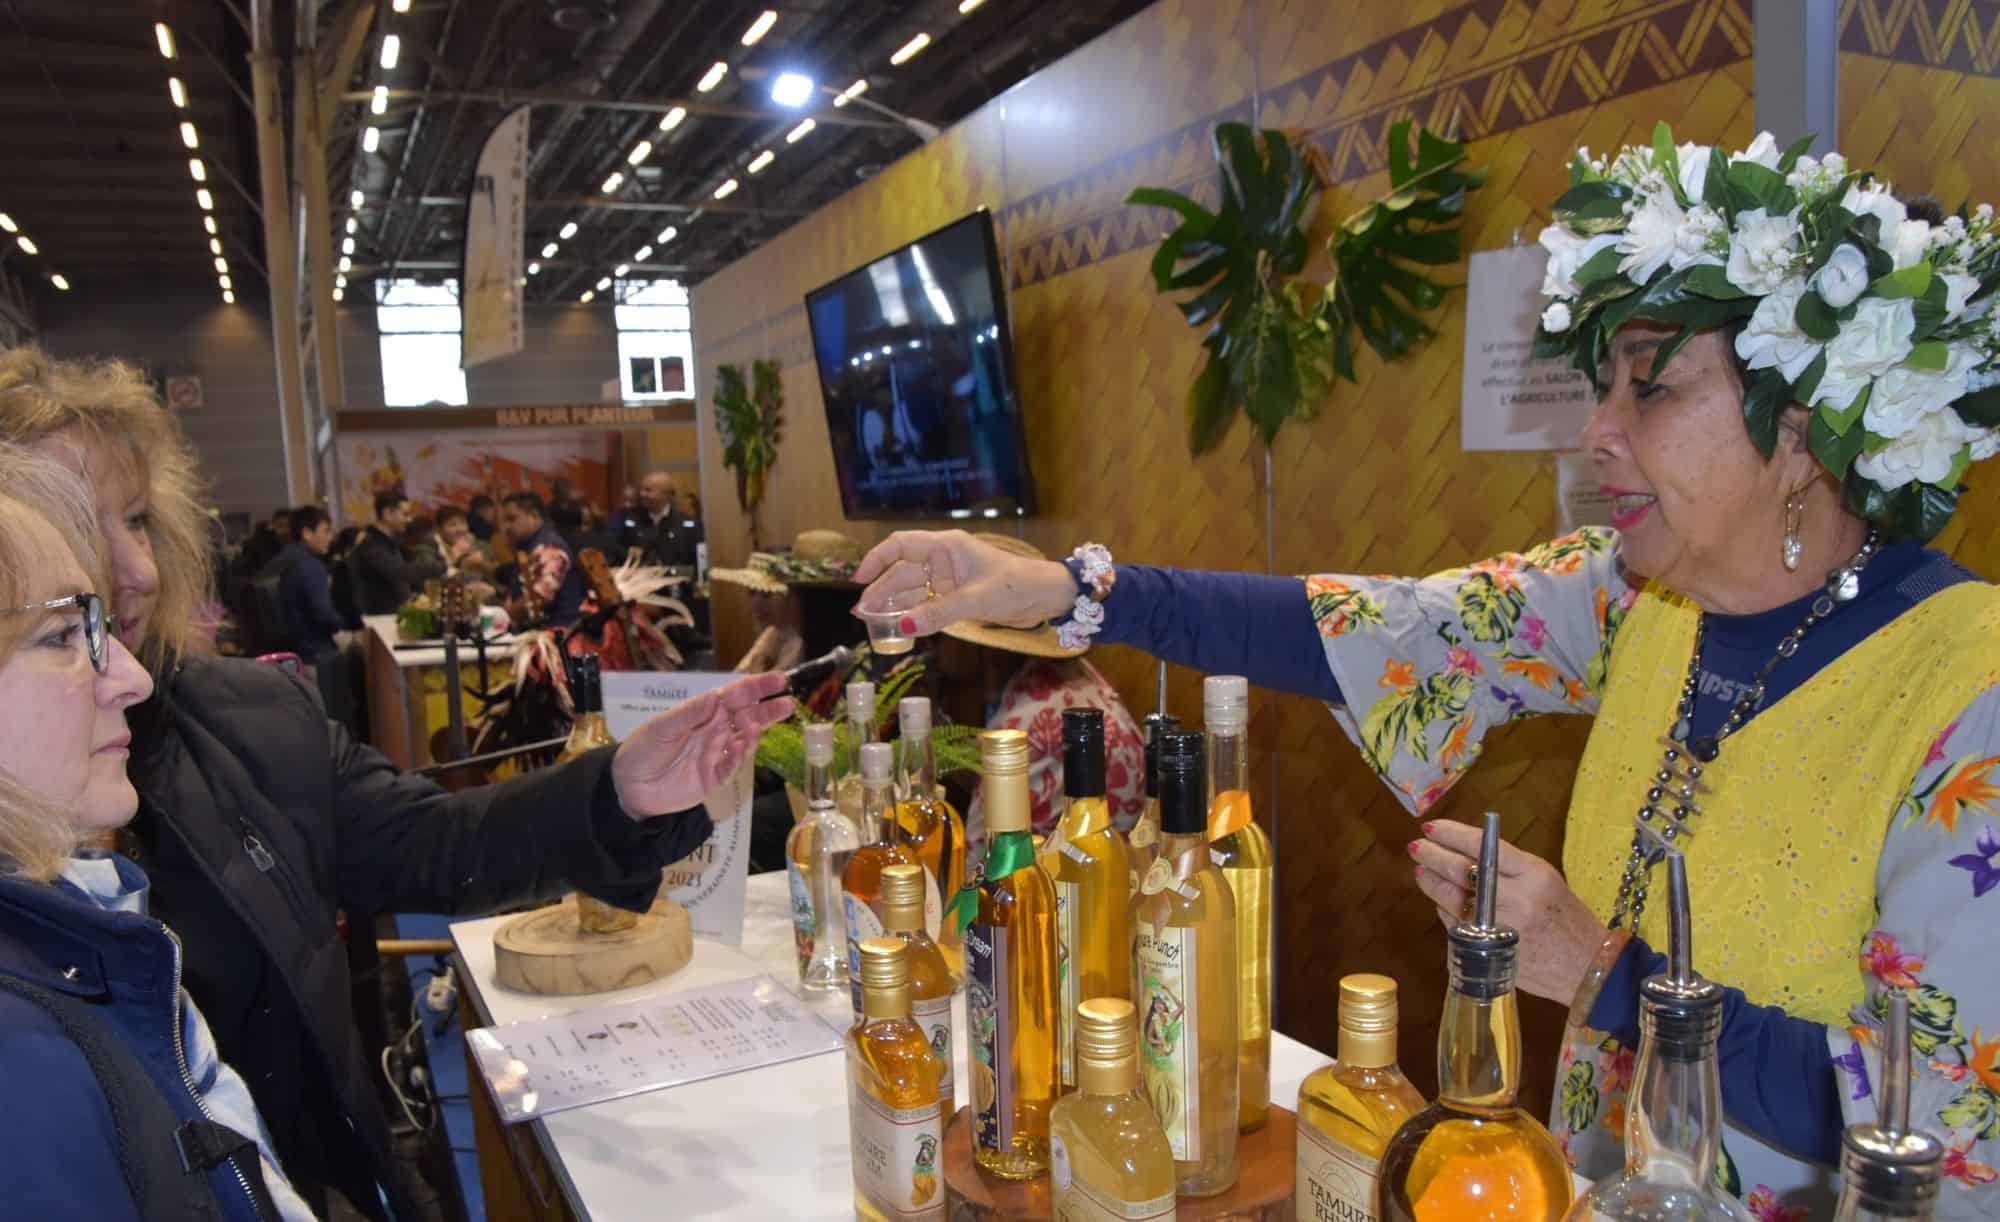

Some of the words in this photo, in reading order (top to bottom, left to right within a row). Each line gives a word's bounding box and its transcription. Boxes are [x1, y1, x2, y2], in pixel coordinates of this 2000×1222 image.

[1545, 372, 1582, 384] SALON
[1699, 671, 1760, 707] IPST
[668, 871, 702, 888] 2023
